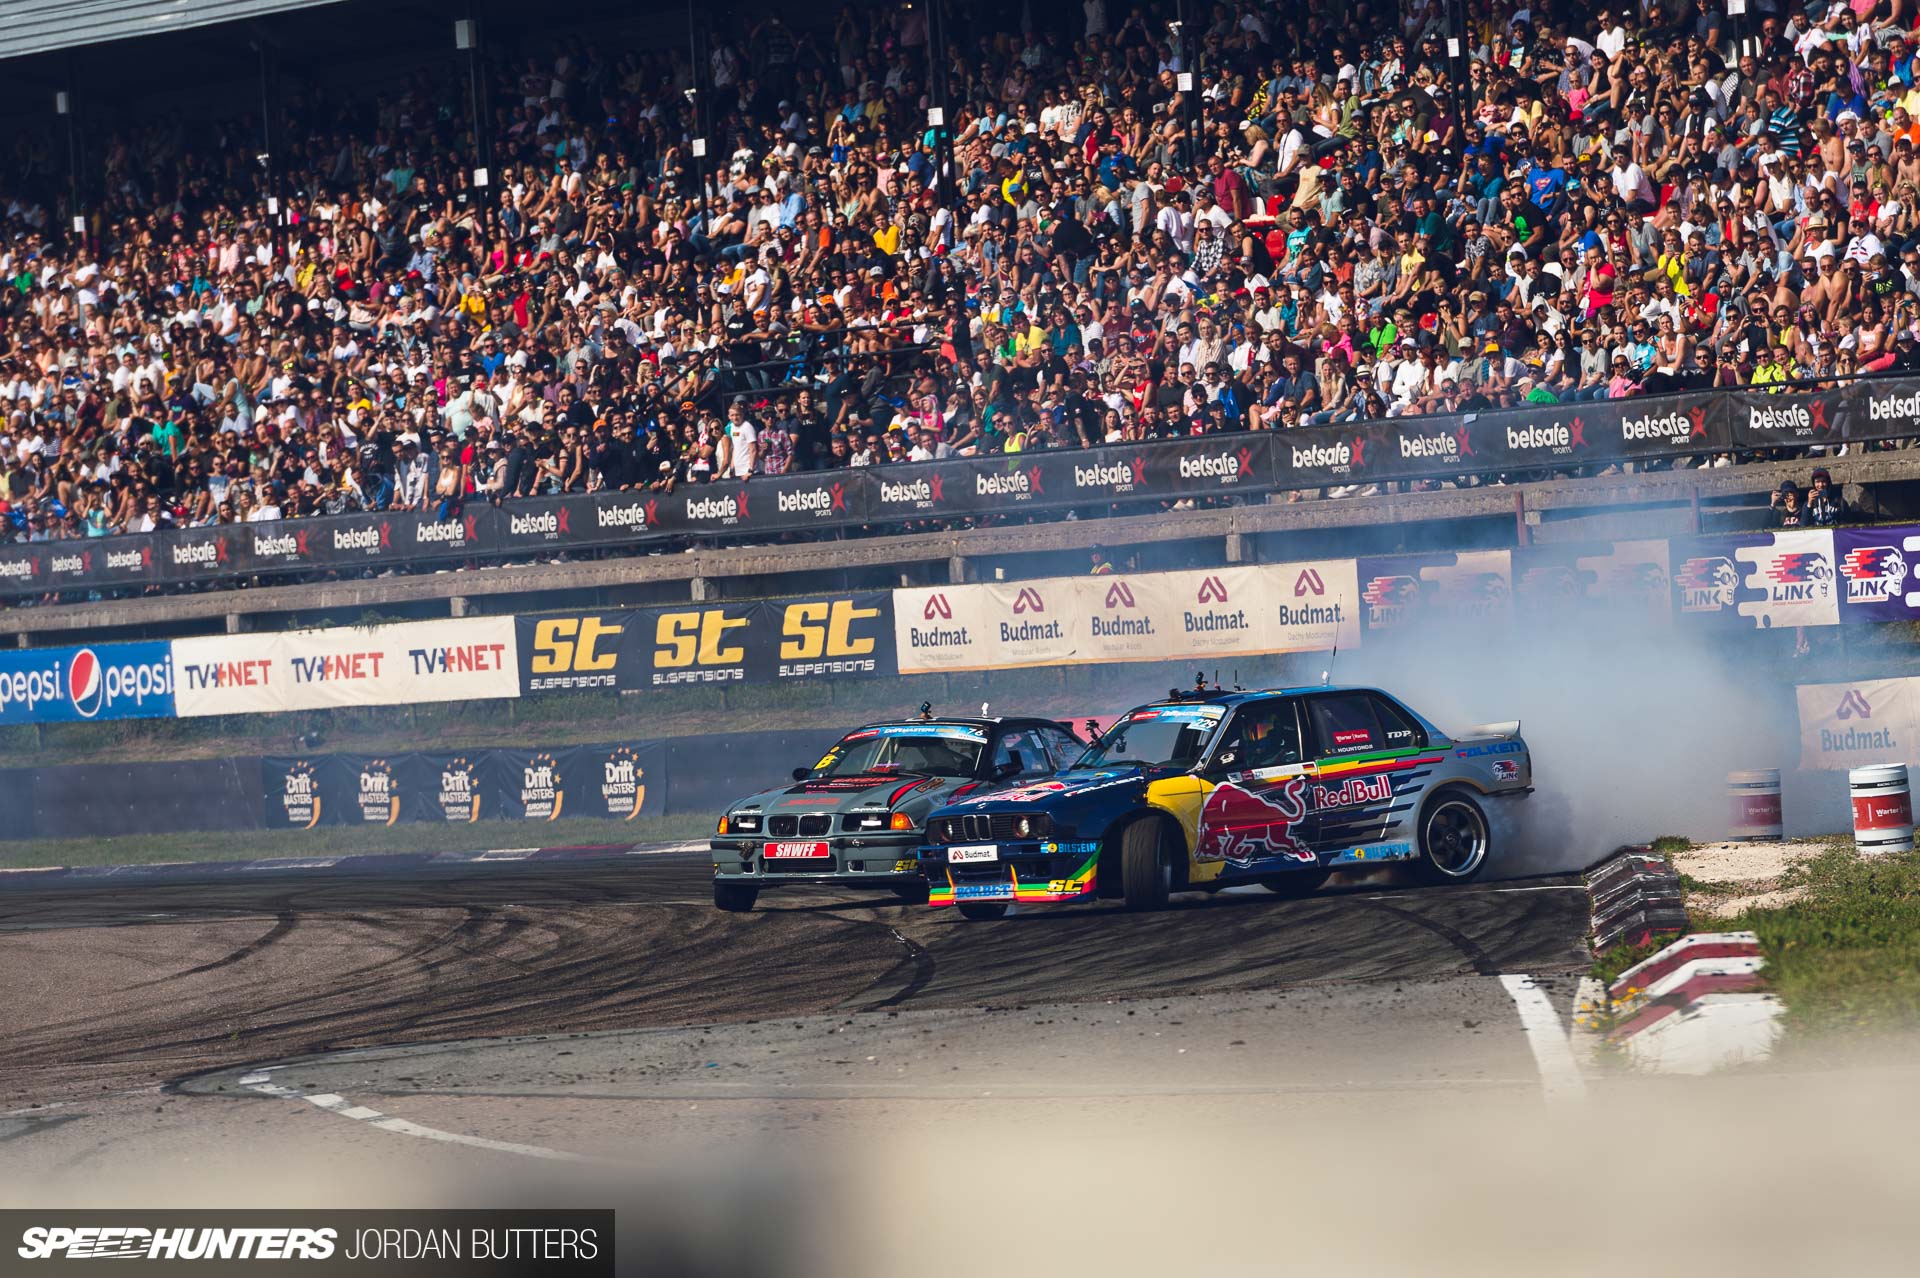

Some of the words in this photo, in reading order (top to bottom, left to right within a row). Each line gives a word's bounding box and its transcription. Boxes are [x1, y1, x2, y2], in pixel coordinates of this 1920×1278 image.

[1869, 391, 1920, 420] betsaf
[1750, 404, 1810, 429] betsafe
[1622, 412, 1690, 440] betsafe
[1795, 428, 1813, 436] SPORTS
[1400, 432, 1457, 457] betsafe
[1507, 422, 1569, 449] betsafe
[1671, 436, 1690, 445] SPORTS
[1292, 441, 1350, 468] betsafe
[1443, 454, 1461, 463] SPORTS
[1552, 446, 1572, 455] SPORTS
[1074, 461, 1132, 487] betsafe
[1179, 452, 1238, 478] betsafe
[1331, 465, 1350, 474] SPORTS
[976, 471, 1029, 495] betsafe
[1115, 484, 1133, 492] SPORTS
[1220, 475, 1238, 483] SPORTS
[778, 487, 831, 512] betsafe
[881, 479, 930, 502] betsafe
[598, 503, 645, 527] betsafe
[687, 495, 737, 519] betsafe
[815, 509, 832, 517] SPORTS
[416, 518, 465, 542] betsafe
[511, 511, 558, 534] betsafe
[631, 524, 648, 532] SPORTS
[722, 517, 738, 525] SPORTS
[254, 533, 297, 556] betsafe
[334, 526, 379, 549] betsafe
[107, 550, 142, 568] betsafe
[173, 541, 217, 564] betsafe
[0, 557, 31, 577] betsafe
[52, 555, 83, 573] betsafe
[1683, 590, 1720, 604] LINK
[1773, 584, 1815, 601] LINK
[1849, 580, 1888, 597] LINK
[1184, 610, 1249, 632] Budmat.
[1279, 604, 1345, 625] Budmat.
[1000, 620, 1063, 642] Budmat.
[1092, 615, 1155, 636] Budmat.
[911, 627, 972, 648] Budmat.
[653, 668, 744, 684] SUSPENSIONS
[779, 659, 875, 677] SUSPENSIONS
[0, 661, 60, 712] pepsi
[106, 654, 174, 708] pepsi
[530, 674, 616, 690] SUSPENSIONS
[967, 728, 984, 736] 76
[1197, 719, 1217, 728] 229
[359, 792, 389, 803] MASTERS
[439, 792, 471, 802] MASTERS
[522, 788, 555, 800] MASTERS
[602, 783, 636, 795] MASTERS
[284, 794, 312, 805] MASTERS
[776, 844, 817, 857] SHWFF
[1058, 843, 1097, 853] BILSTEIN
